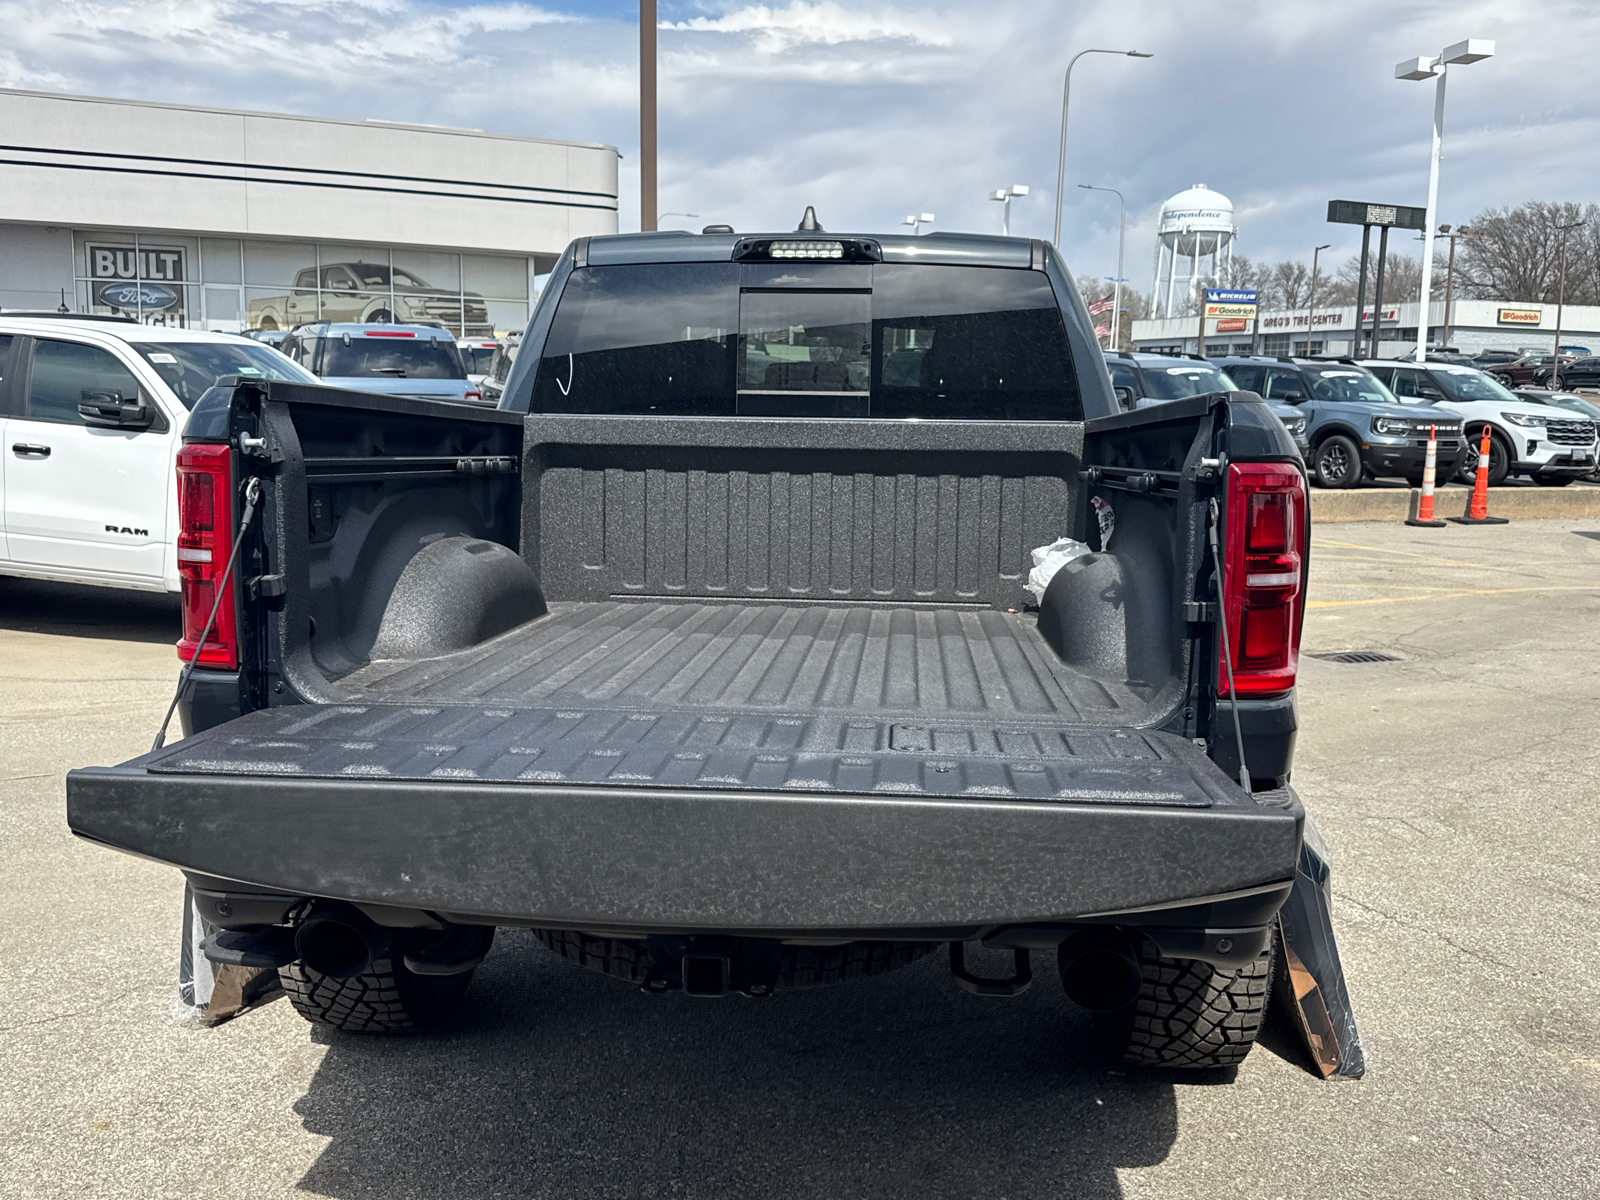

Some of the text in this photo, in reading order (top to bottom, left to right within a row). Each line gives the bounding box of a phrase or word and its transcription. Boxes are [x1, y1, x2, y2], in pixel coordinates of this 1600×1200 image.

[95, 250, 179, 279] BUILT
[119, 287, 158, 304] Ford
[1208, 306, 1254, 315] BFGoodrich
[1503, 312, 1539, 321] BFGoodrich
[1293, 315, 1309, 326] TIRE
[1311, 313, 1343, 325] CENTER
[105, 524, 149, 537] RAM
